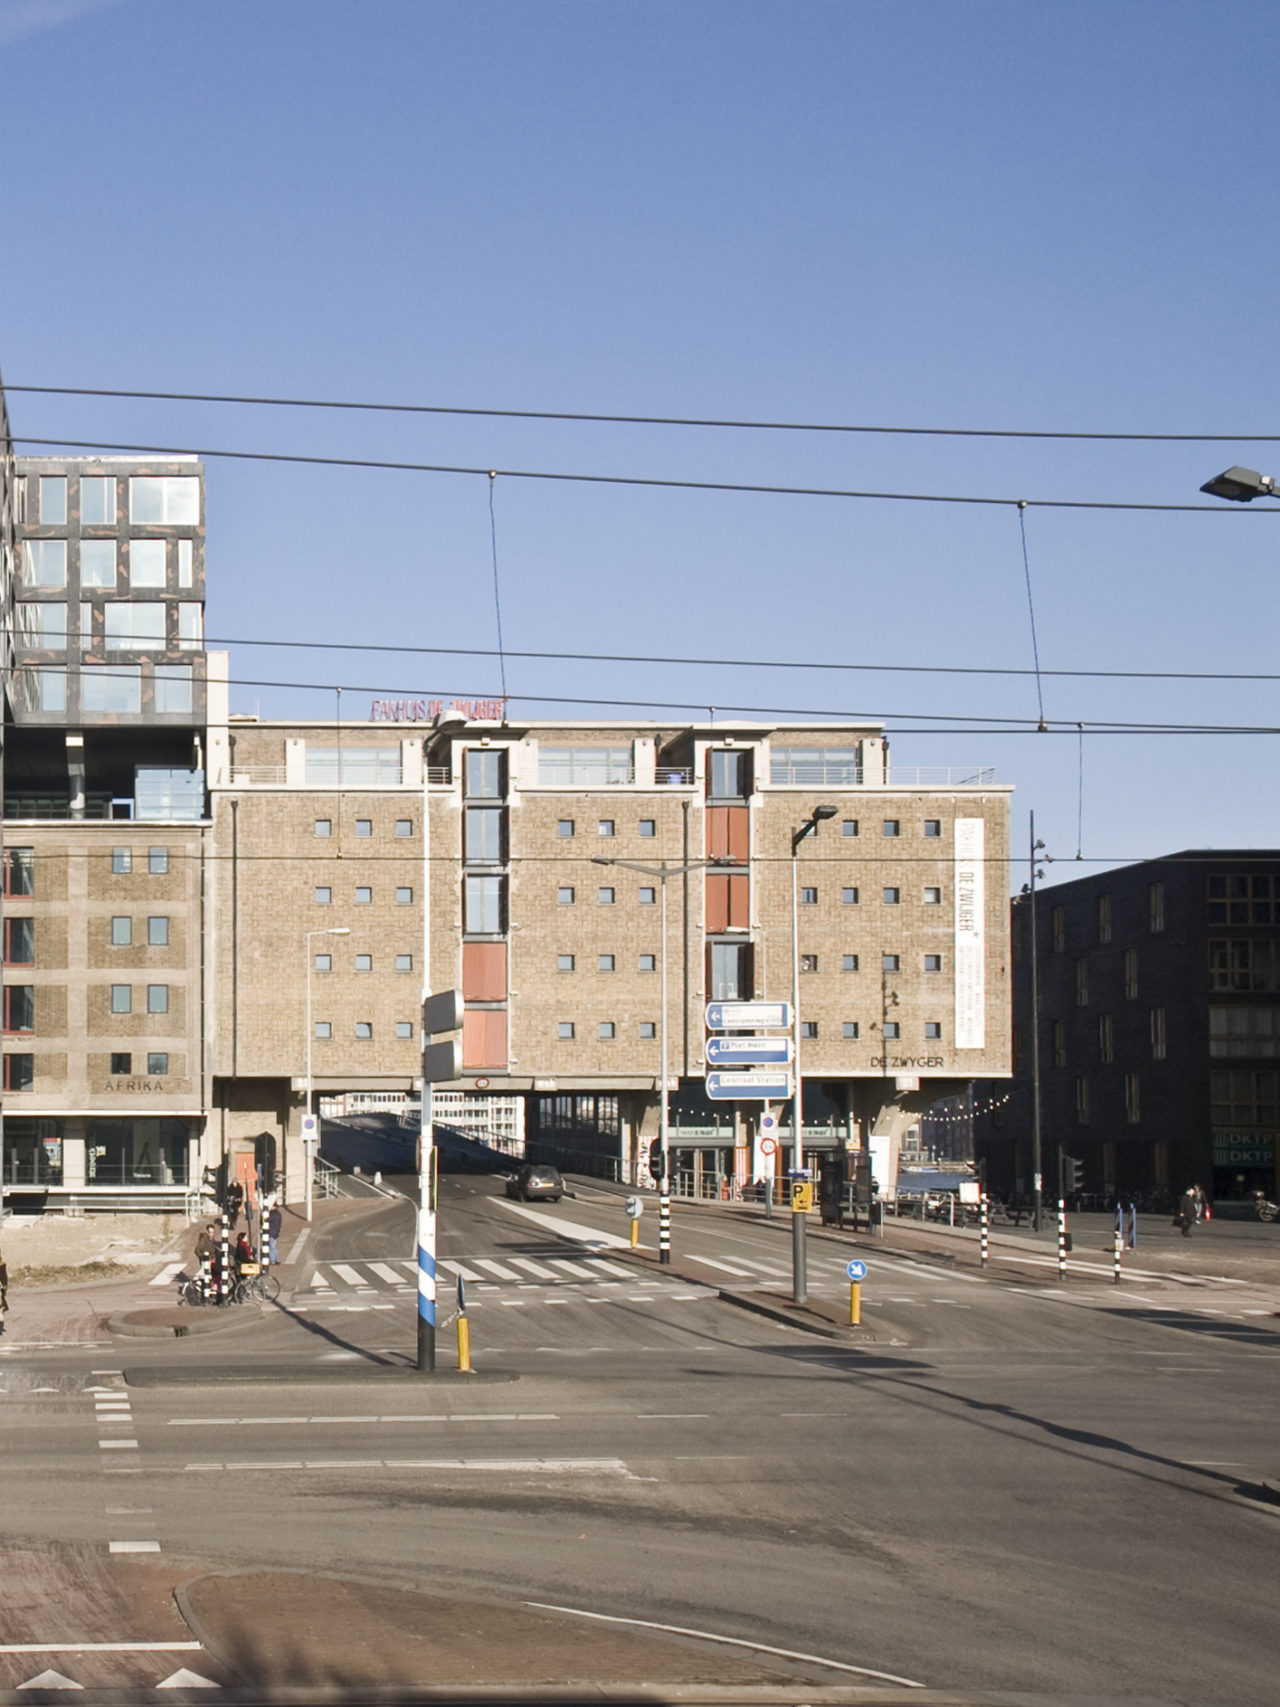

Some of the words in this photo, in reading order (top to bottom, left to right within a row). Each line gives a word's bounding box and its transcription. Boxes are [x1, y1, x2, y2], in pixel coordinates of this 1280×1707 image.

[959, 822, 975, 869] PAKHUS
[959, 872, 975, 884] DE
[959, 886, 975, 932] ZWIJGER
[870, 1056, 887, 1068] DE
[891, 1056, 944, 1068] ZWYGER
[104, 1080, 164, 1092] AFRIKA
[793, 1184, 804, 1198] P
